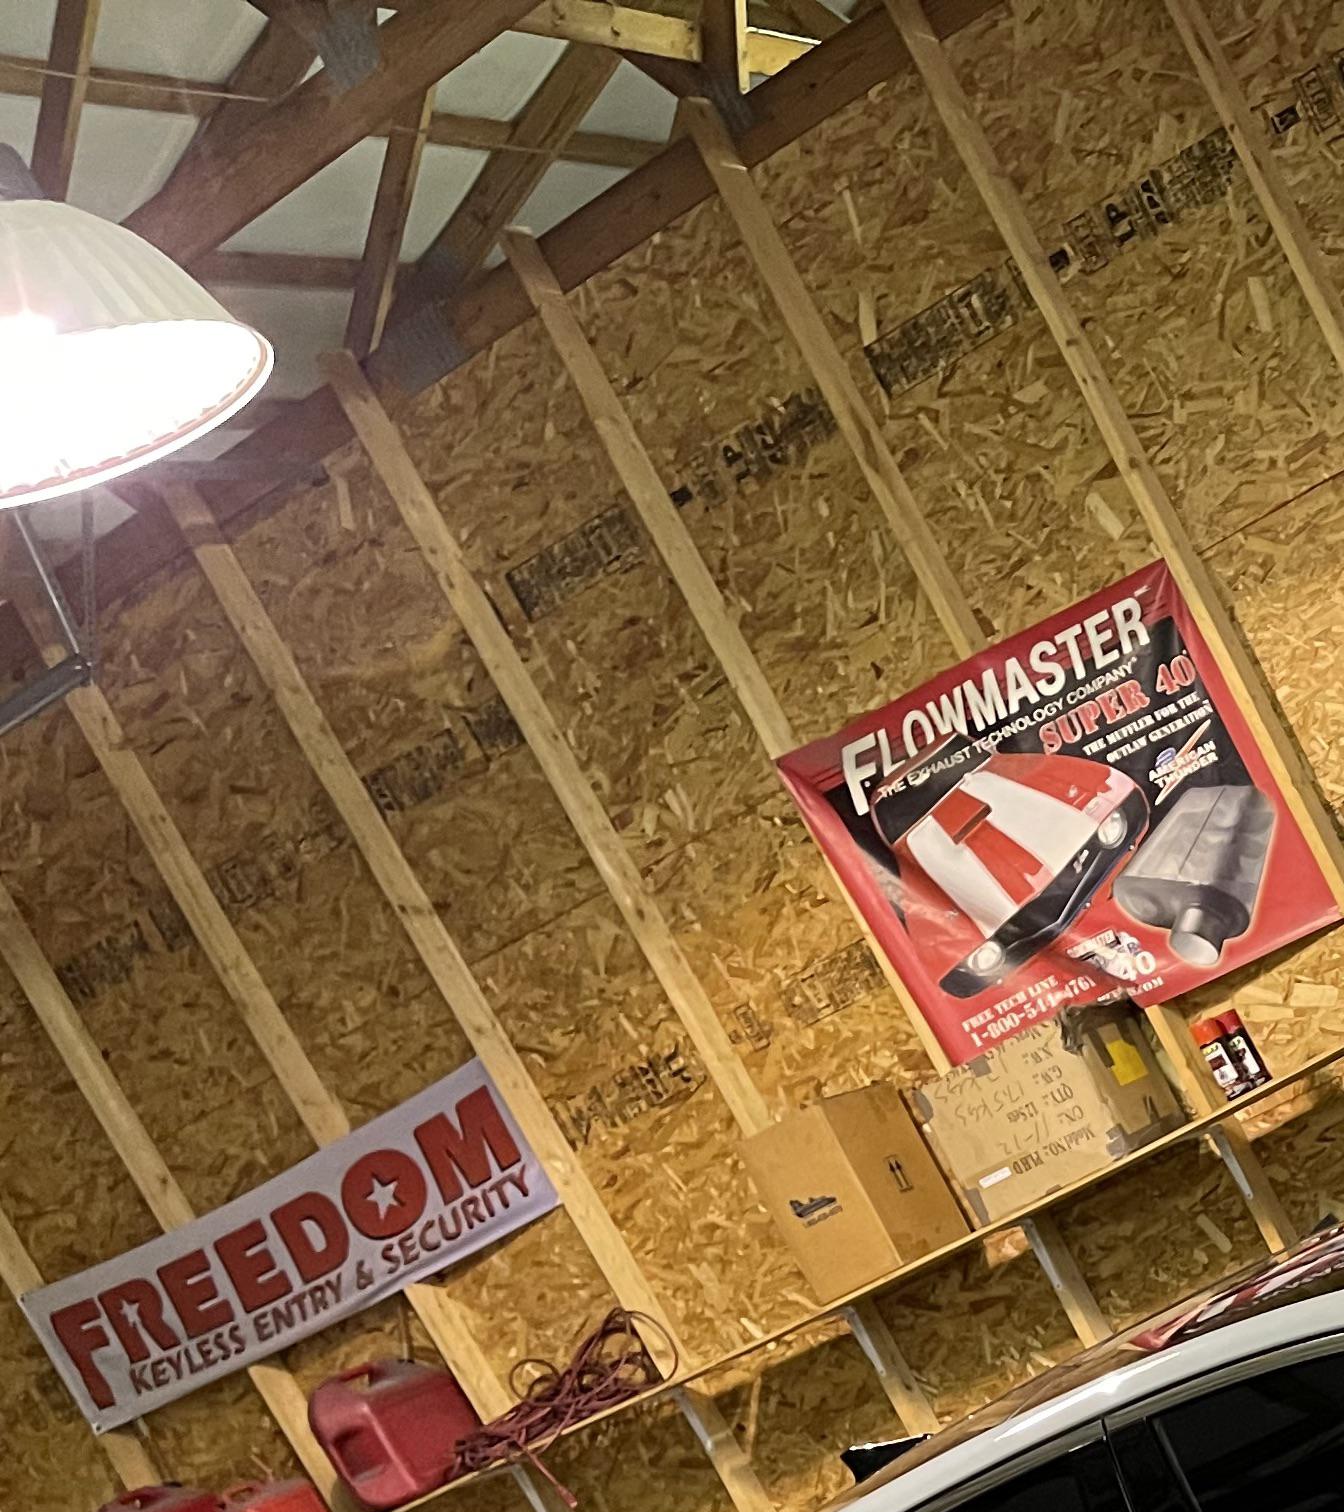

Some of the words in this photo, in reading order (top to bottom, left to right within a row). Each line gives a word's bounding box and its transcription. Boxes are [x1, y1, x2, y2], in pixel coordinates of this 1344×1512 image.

[842, 597, 1151, 815] FLOWMASTER
[908, 750, 972, 786] EXHAUST
[974, 699, 1064, 756] TECHNOLOGY
[1039, 679, 1151, 755] SUPER
[1155, 654, 1197, 695] 40
[1149, 741, 1217, 782] AMERICAN
[961, 1007, 996, 1032] FREE
[994, 991, 1028, 1015] TECH
[1027, 974, 1059, 998] LINE
[51, 1085, 522, 1410] FREEDOM
[130, 1325, 247, 1396] KEYLESS
[254, 1273, 344, 1342] ENTRY
[356, 1260, 375, 1291] &
[381, 1165, 531, 1275] SECURITY
